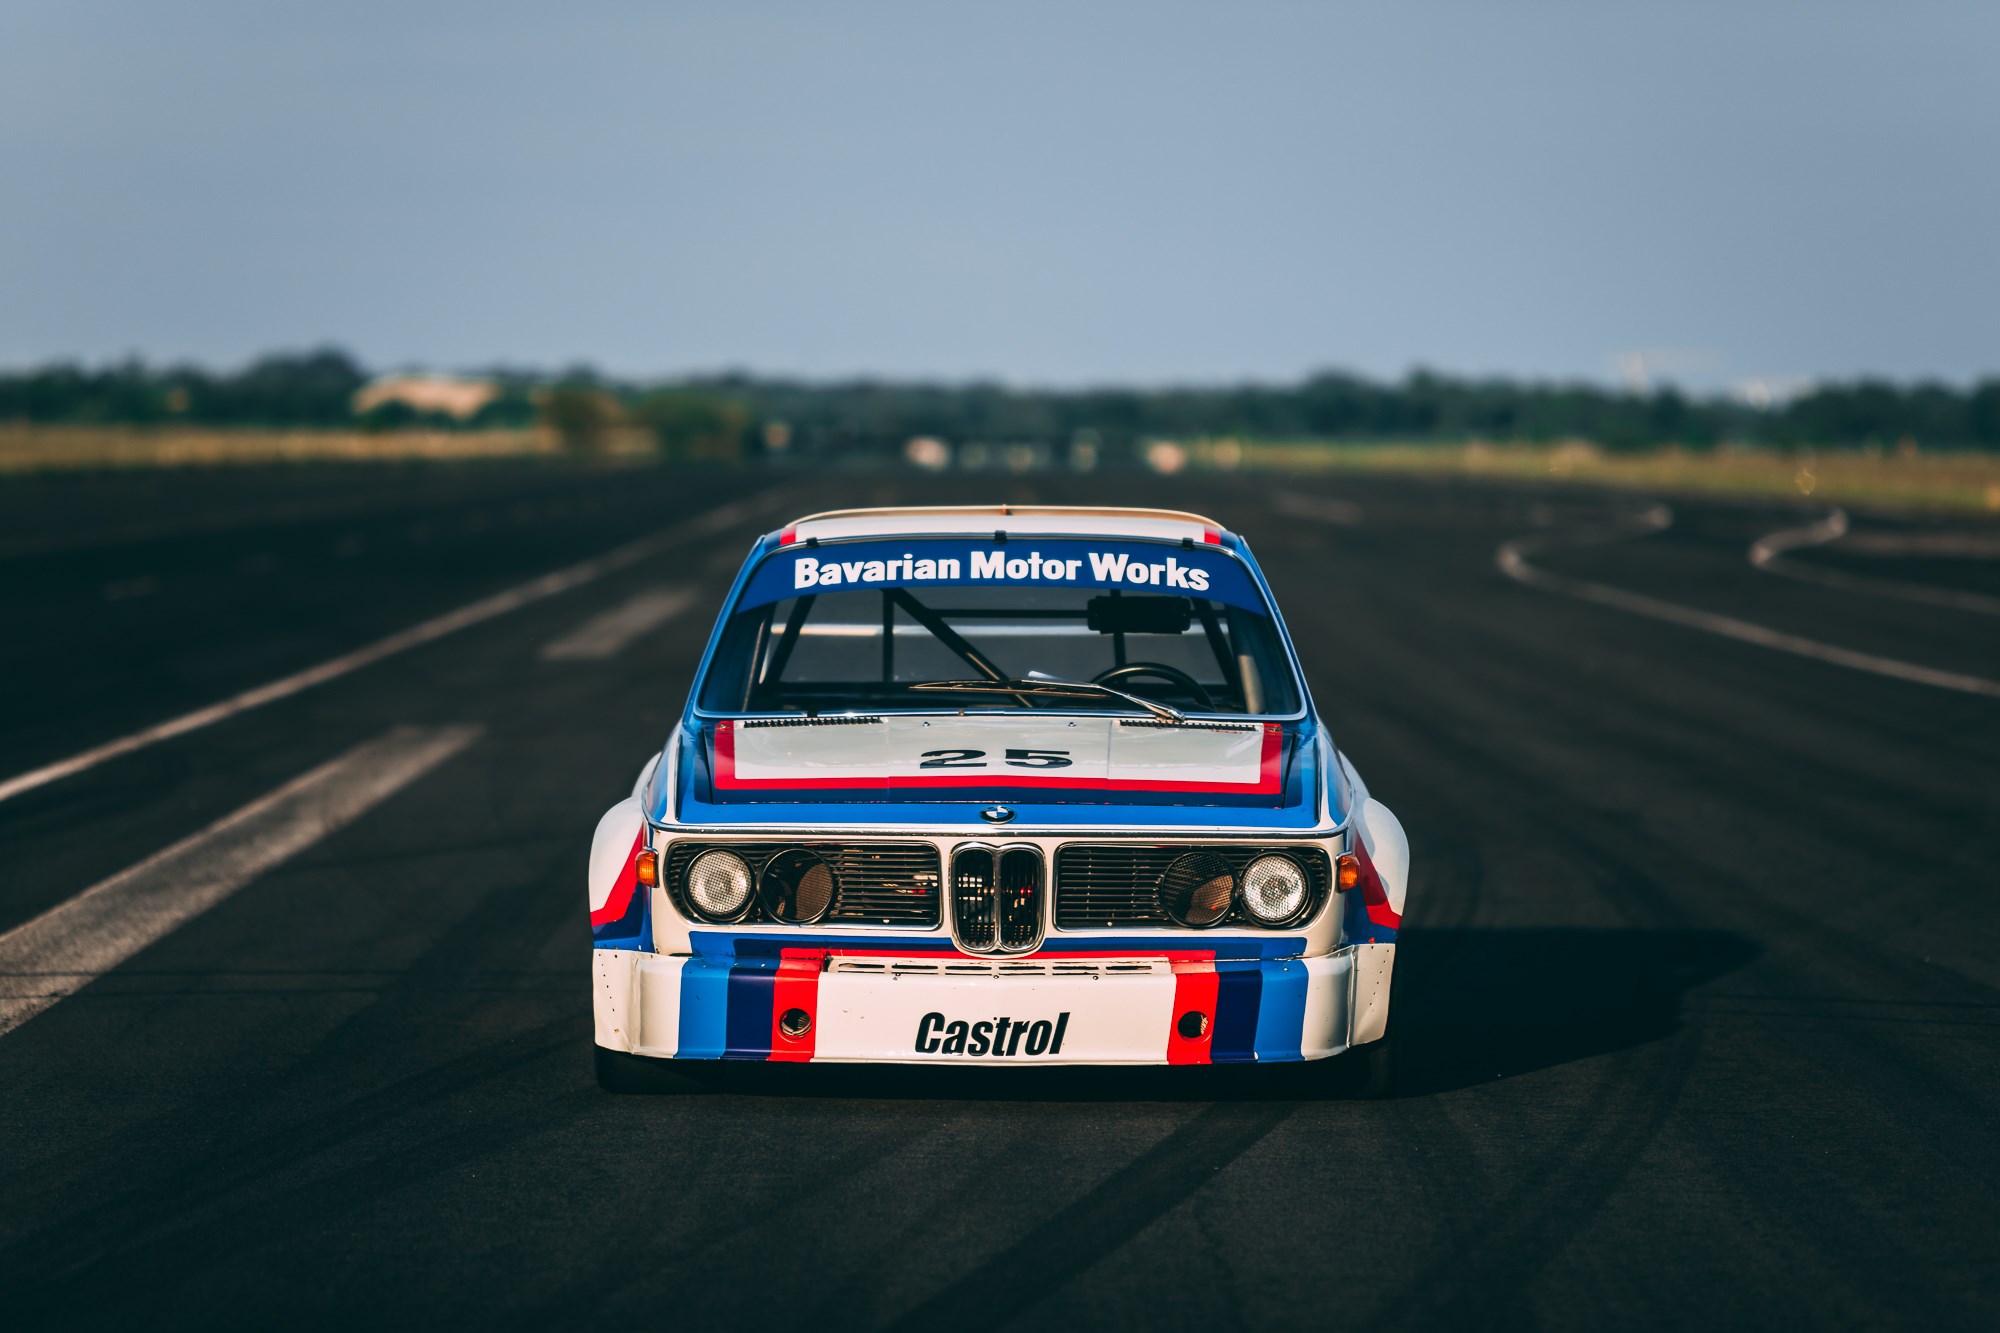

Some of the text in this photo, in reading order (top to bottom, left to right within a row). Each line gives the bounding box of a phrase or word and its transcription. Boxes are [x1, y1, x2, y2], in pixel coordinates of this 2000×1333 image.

[794, 551, 1210, 591] Bavarian Motor Works
[919, 748, 1074, 770] 25
[914, 1011, 1071, 1057] Castrol
